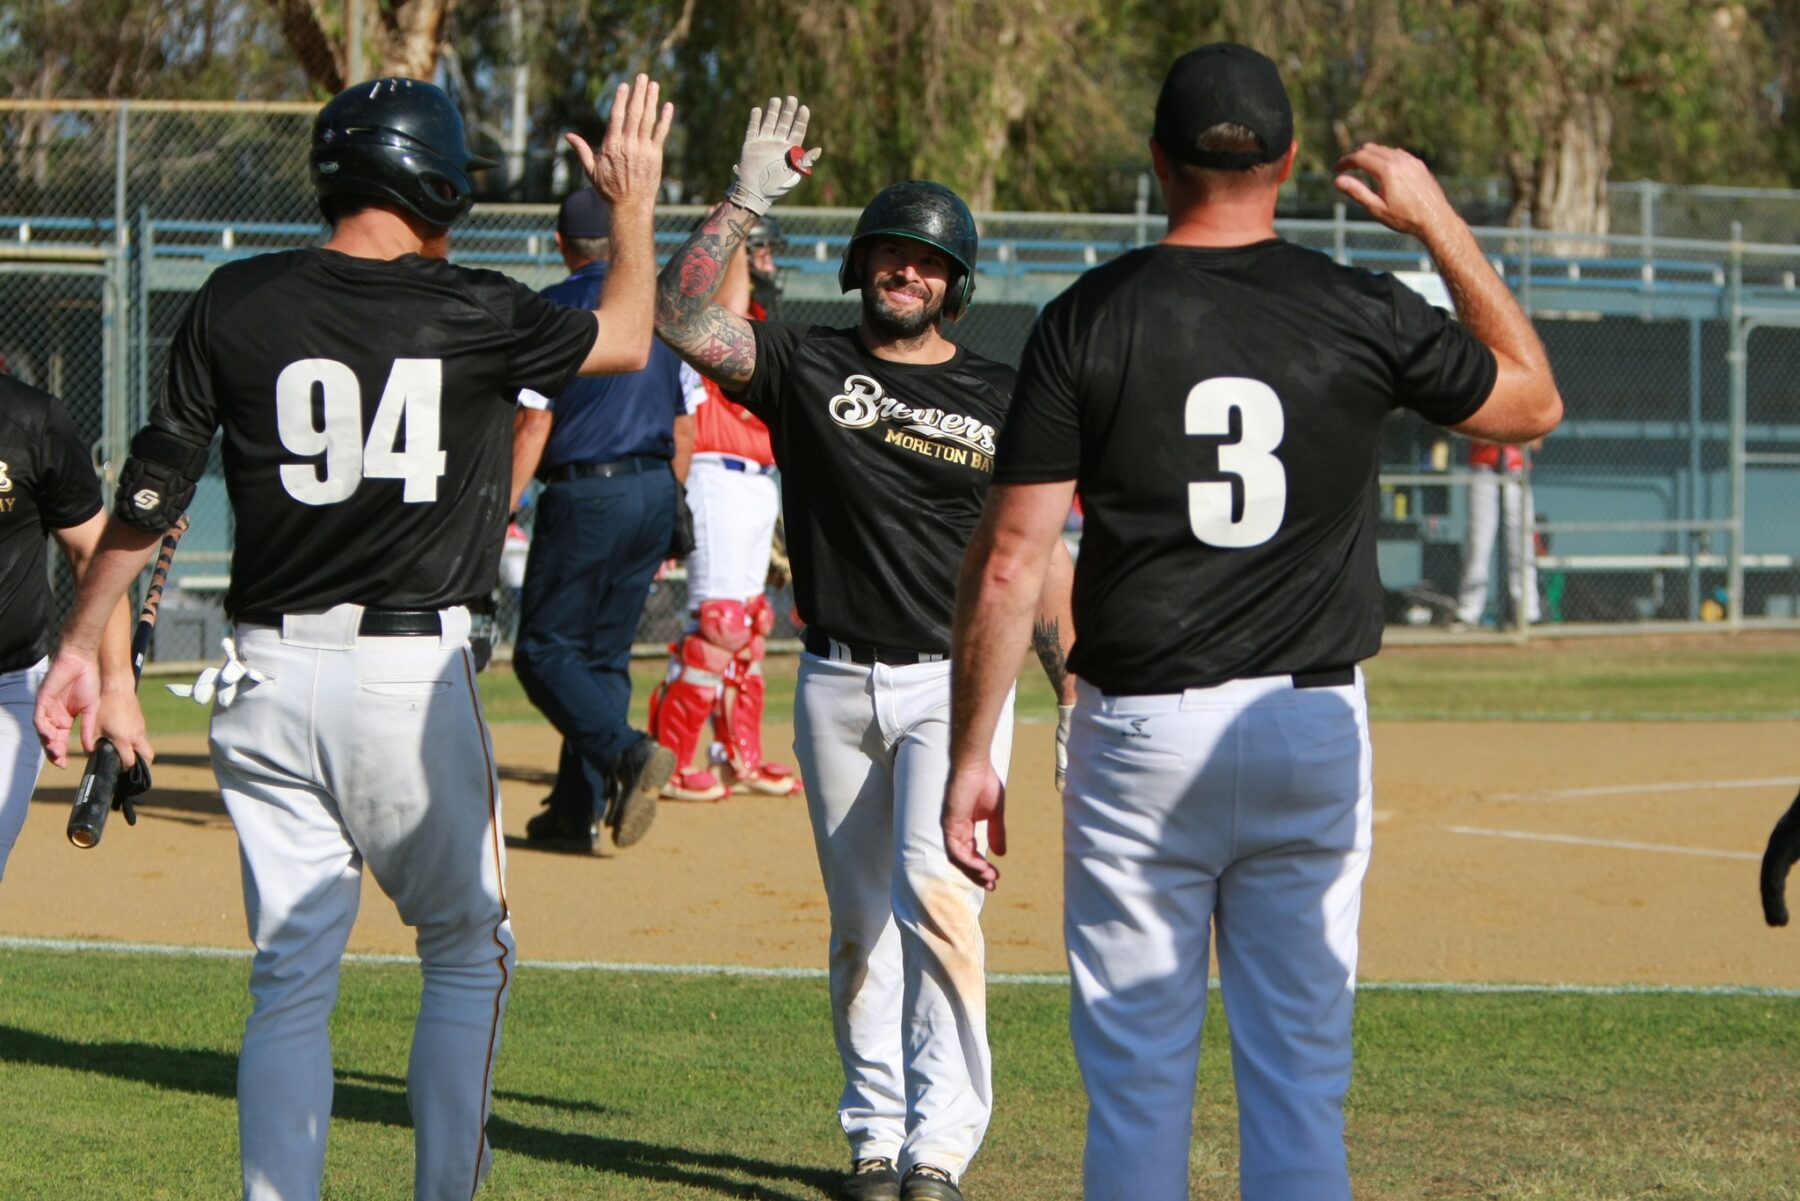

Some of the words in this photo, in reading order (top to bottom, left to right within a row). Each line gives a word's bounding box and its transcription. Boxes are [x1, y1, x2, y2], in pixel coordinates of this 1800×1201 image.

[276, 358, 447, 506] 94
[829, 374, 996, 457] Brewers
[884, 429, 968, 466] MORETON
[1185, 376, 1287, 548] 3
